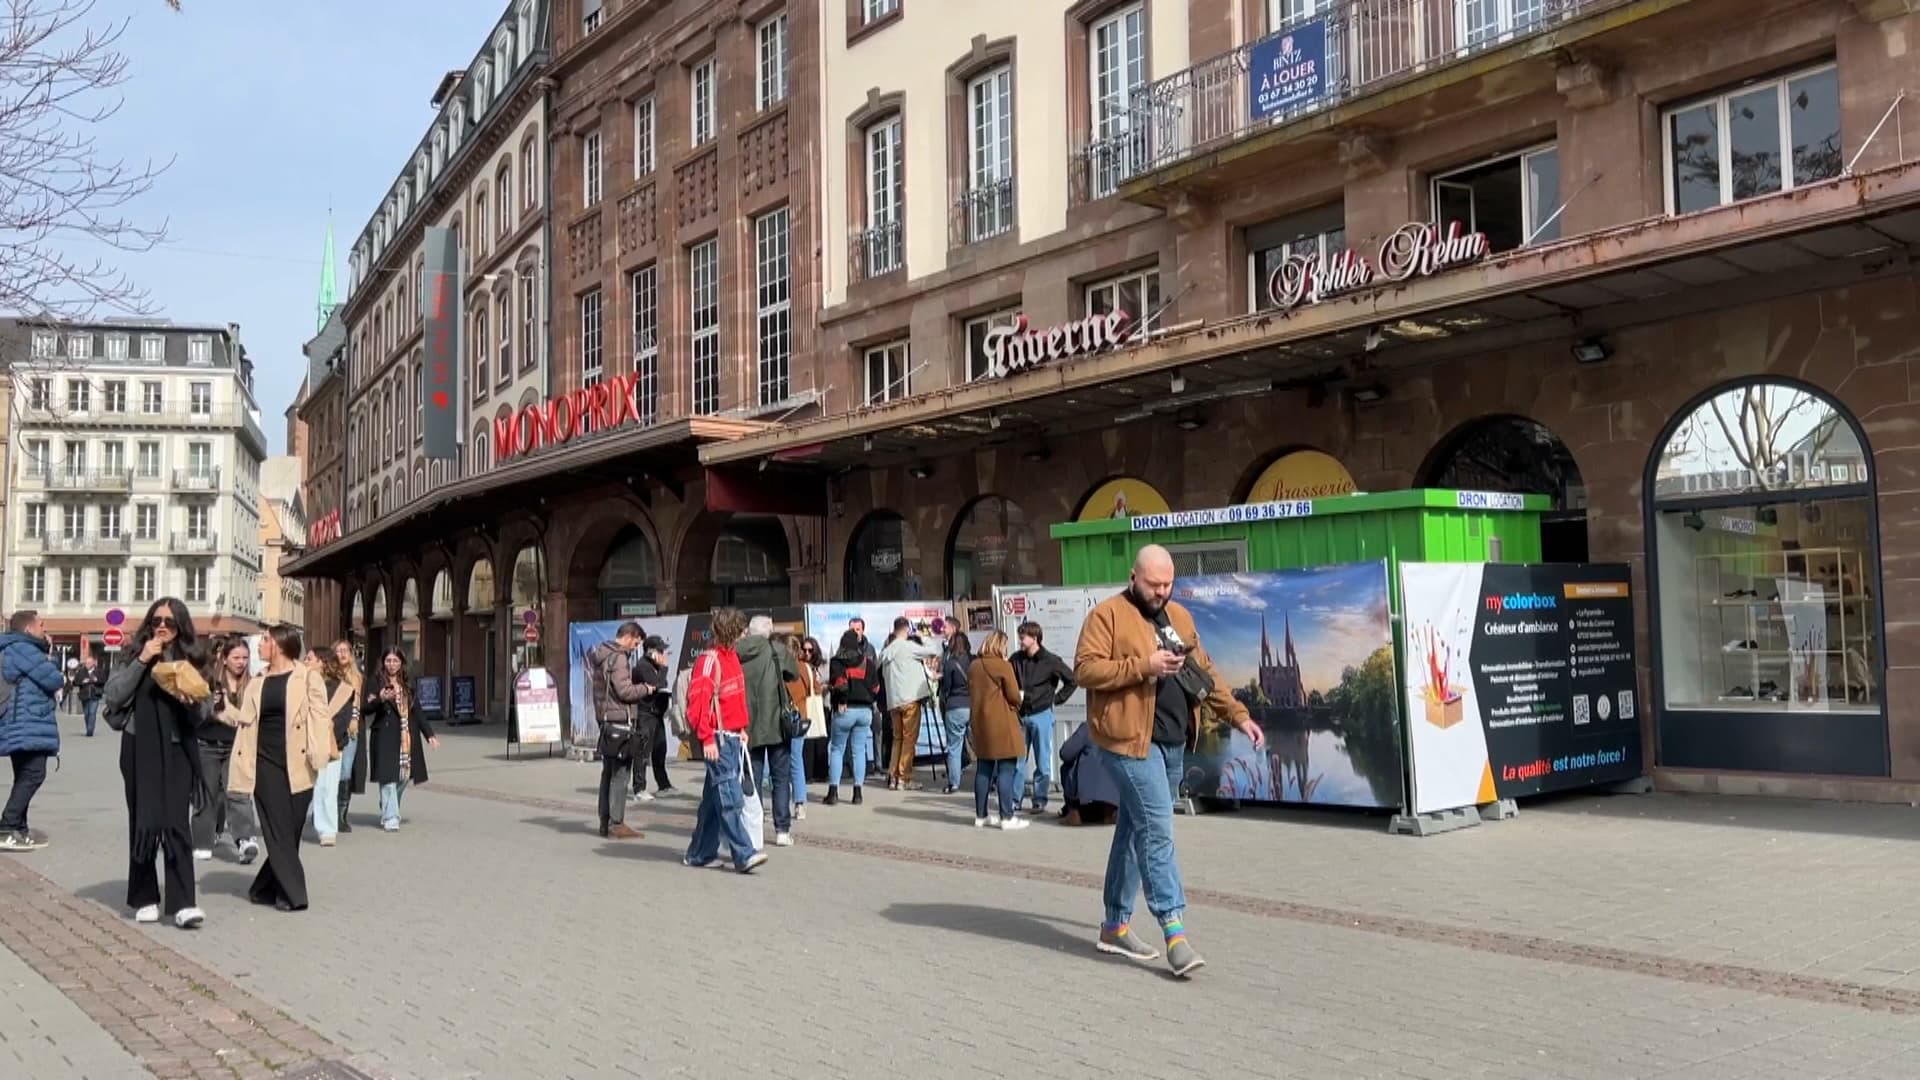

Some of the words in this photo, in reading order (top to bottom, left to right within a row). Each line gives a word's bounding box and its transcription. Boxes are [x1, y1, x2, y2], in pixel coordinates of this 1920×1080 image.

[1258, 93, 1269, 104] 03
[1270, 88, 1281, 100] 67
[1294, 79, 1306, 92] 30
[1306, 74, 1318, 86] 20
[1260, 74, 1270, 92] À
[1273, 60, 1316, 87] LOUER
[1269, 246, 1374, 308] Kohler
[1379, 219, 1489, 281] Rehm
[982, 308, 1130, 378] Taverne
[493, 371, 640, 463] MONOPRIX
[1270, 478, 1352, 501] Brasserie
[1459, 492, 1488, 506] DRON
[1133, 515, 1168, 530] DRON
[1172, 511, 1215, 526] LOCATION
[1229, 507, 1242, 521] 09
[1245, 505, 1259, 519] 69
[1262, 504, 1276, 517] 36
[1279, 502, 1292, 516] 37
[1296, 501, 1310, 515] 66
[1486, 592, 1557, 614] mycolorbox
[1484, 619, 1516, 635] Créateur
[1517, 619, 1559, 634] d'ambiance
[1502, 764, 1516, 781] La
[1517, 757, 1551, 782] qualité
[1553, 753, 1569, 771] est
[1570, 751, 1596, 769] notre
[1597, 749, 1621, 767] force
